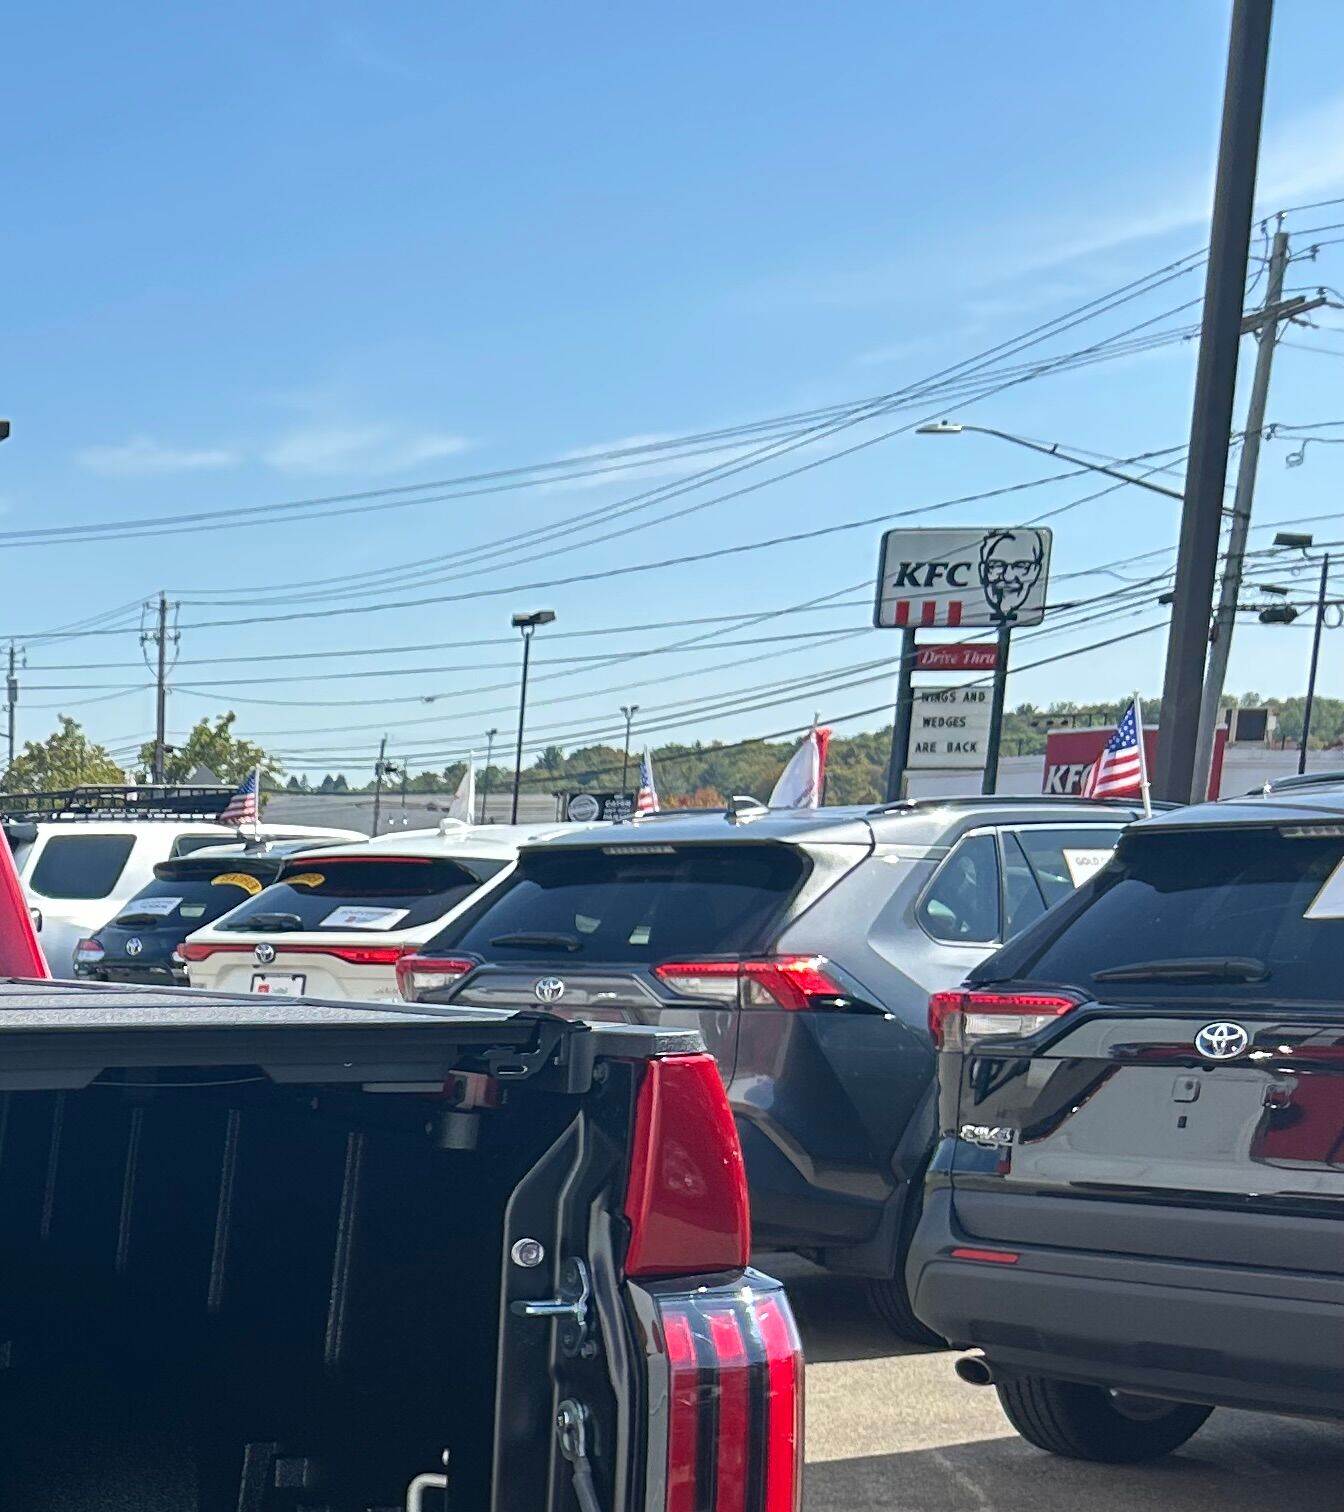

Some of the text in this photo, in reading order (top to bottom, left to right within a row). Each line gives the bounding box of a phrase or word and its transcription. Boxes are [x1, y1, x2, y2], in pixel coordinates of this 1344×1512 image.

[893, 561, 972, 587] KFC
[920, 650, 997, 665] Drive Thru
[921, 691, 986, 703] WINGS AND
[922, 716, 966, 728] WEDGES
[915, 742, 977, 753] ARE BACK
